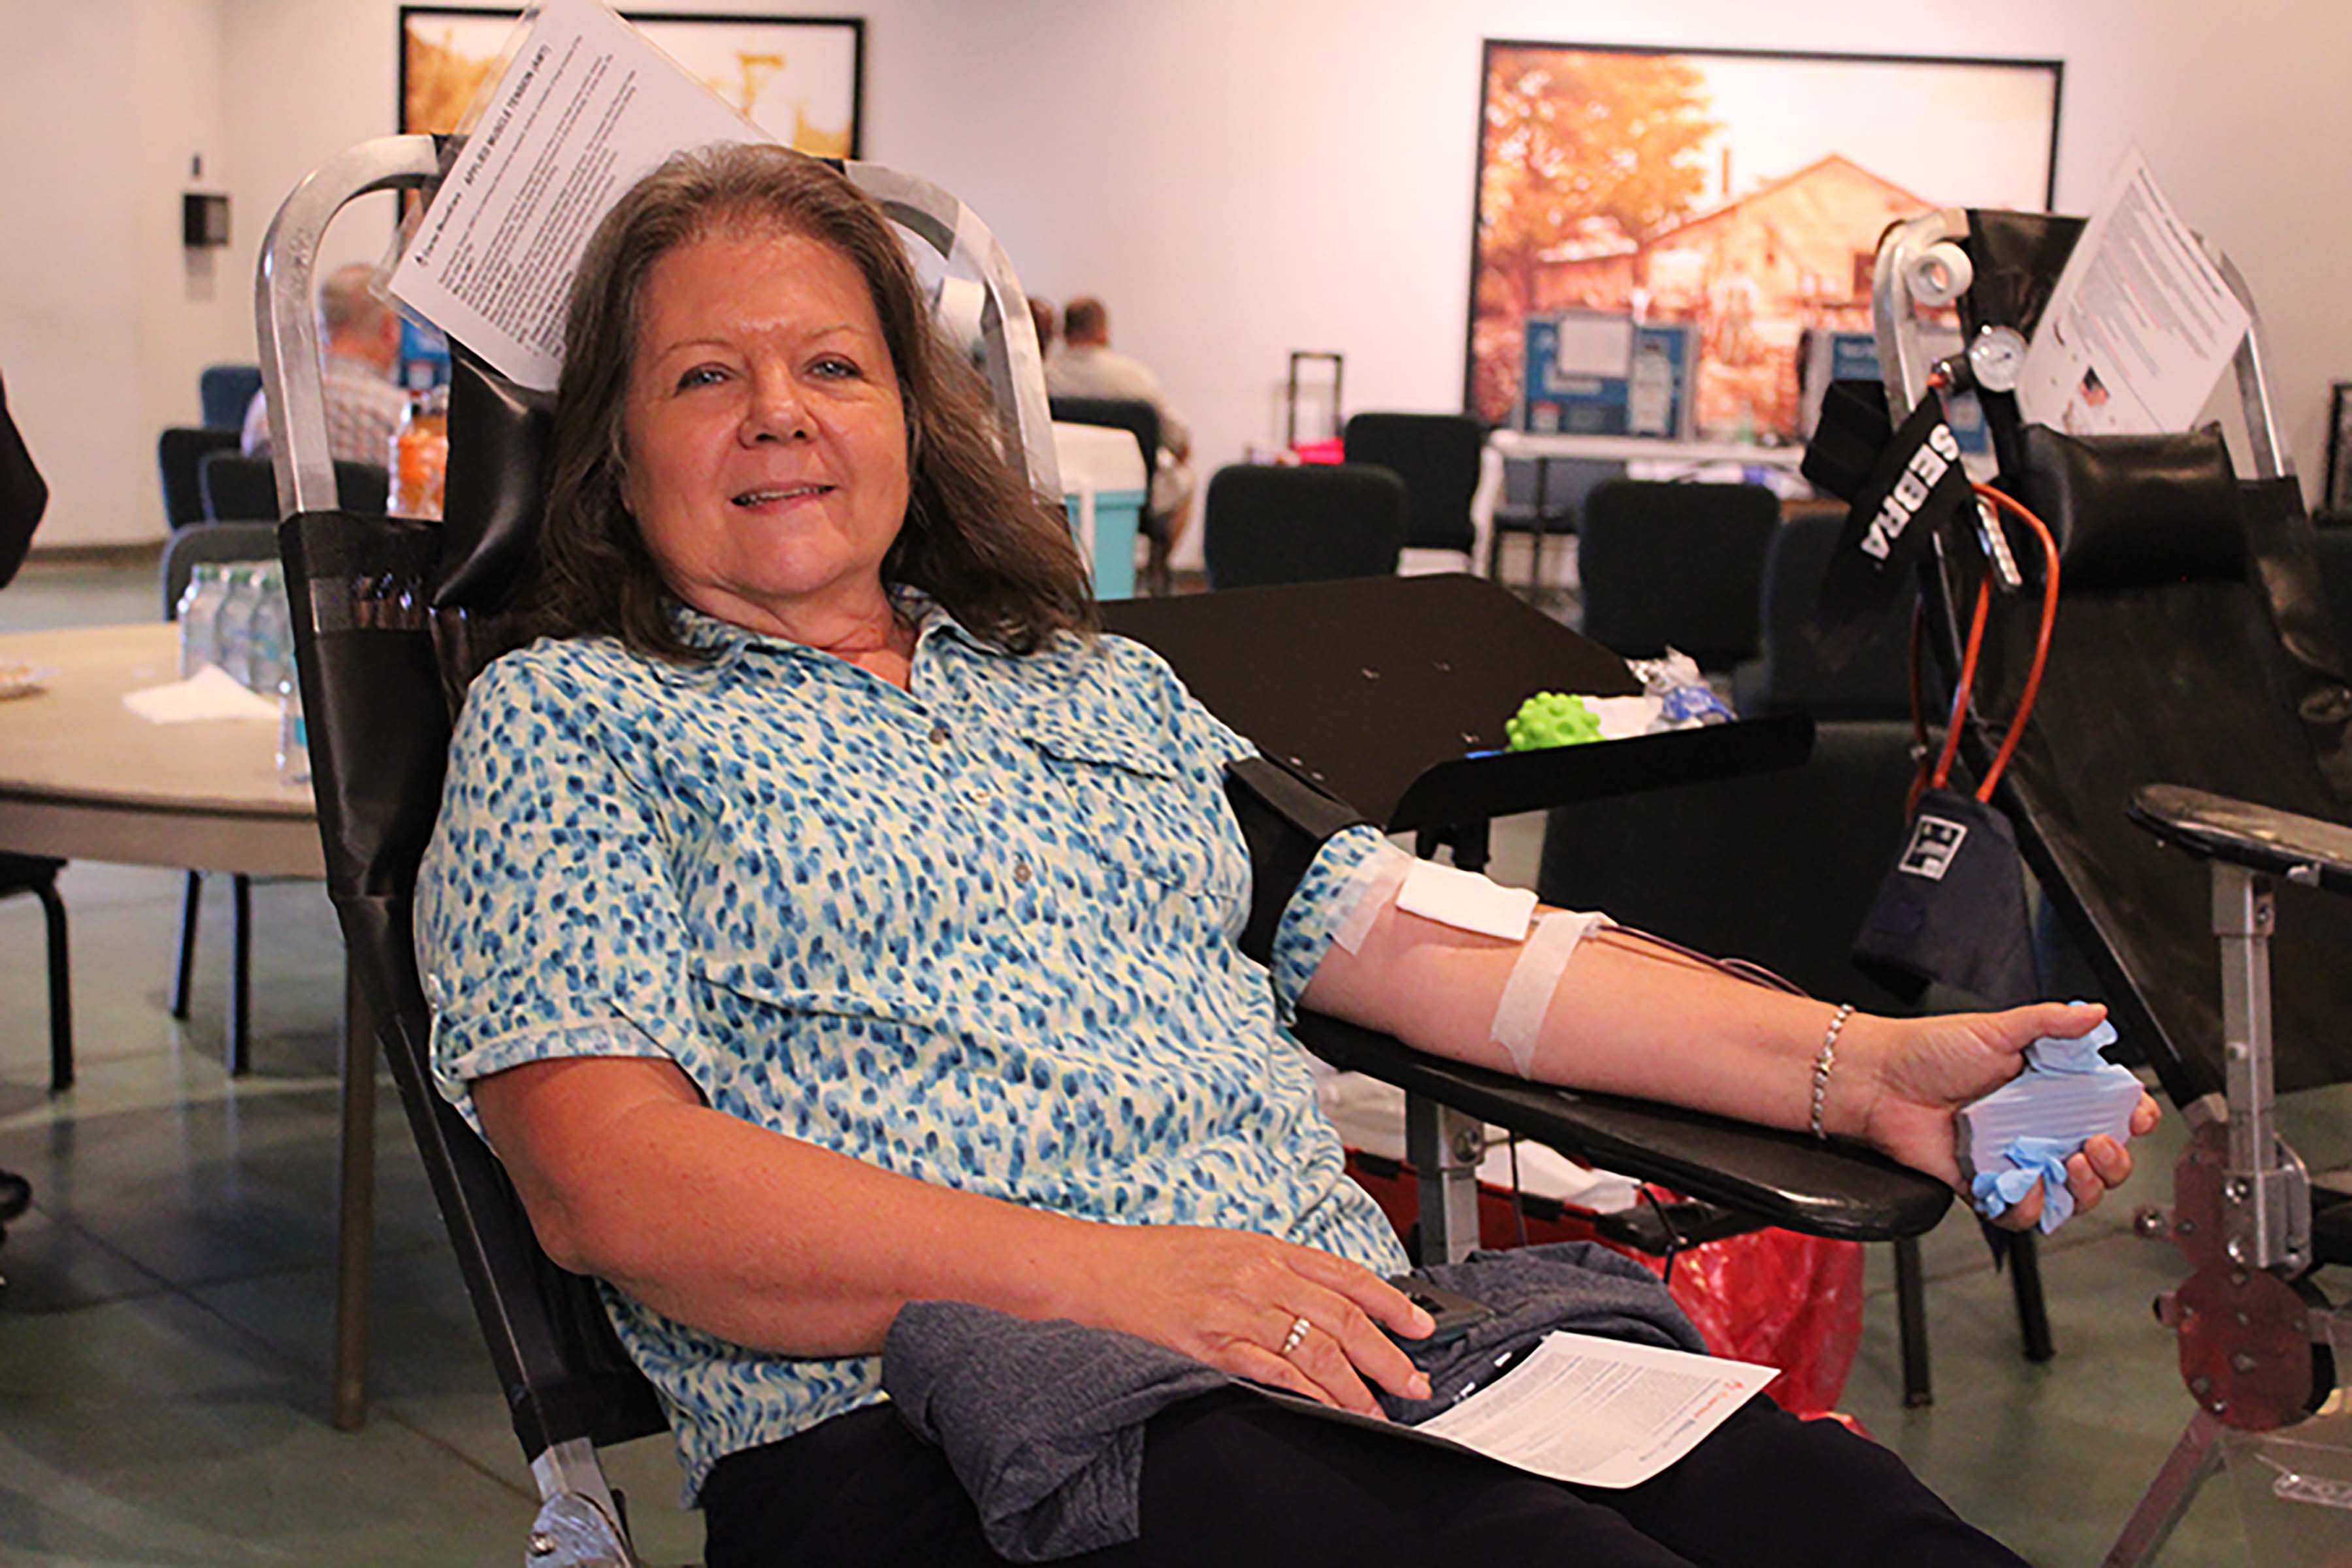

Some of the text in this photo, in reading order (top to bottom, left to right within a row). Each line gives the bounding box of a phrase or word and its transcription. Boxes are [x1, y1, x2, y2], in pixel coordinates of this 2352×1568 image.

[461, 146, 491, 186] APPLIED
[483, 108, 512, 147] MUSCLE
[506, 70, 535, 110] TENSION
[1861, 423, 1960, 560] SEBRA
